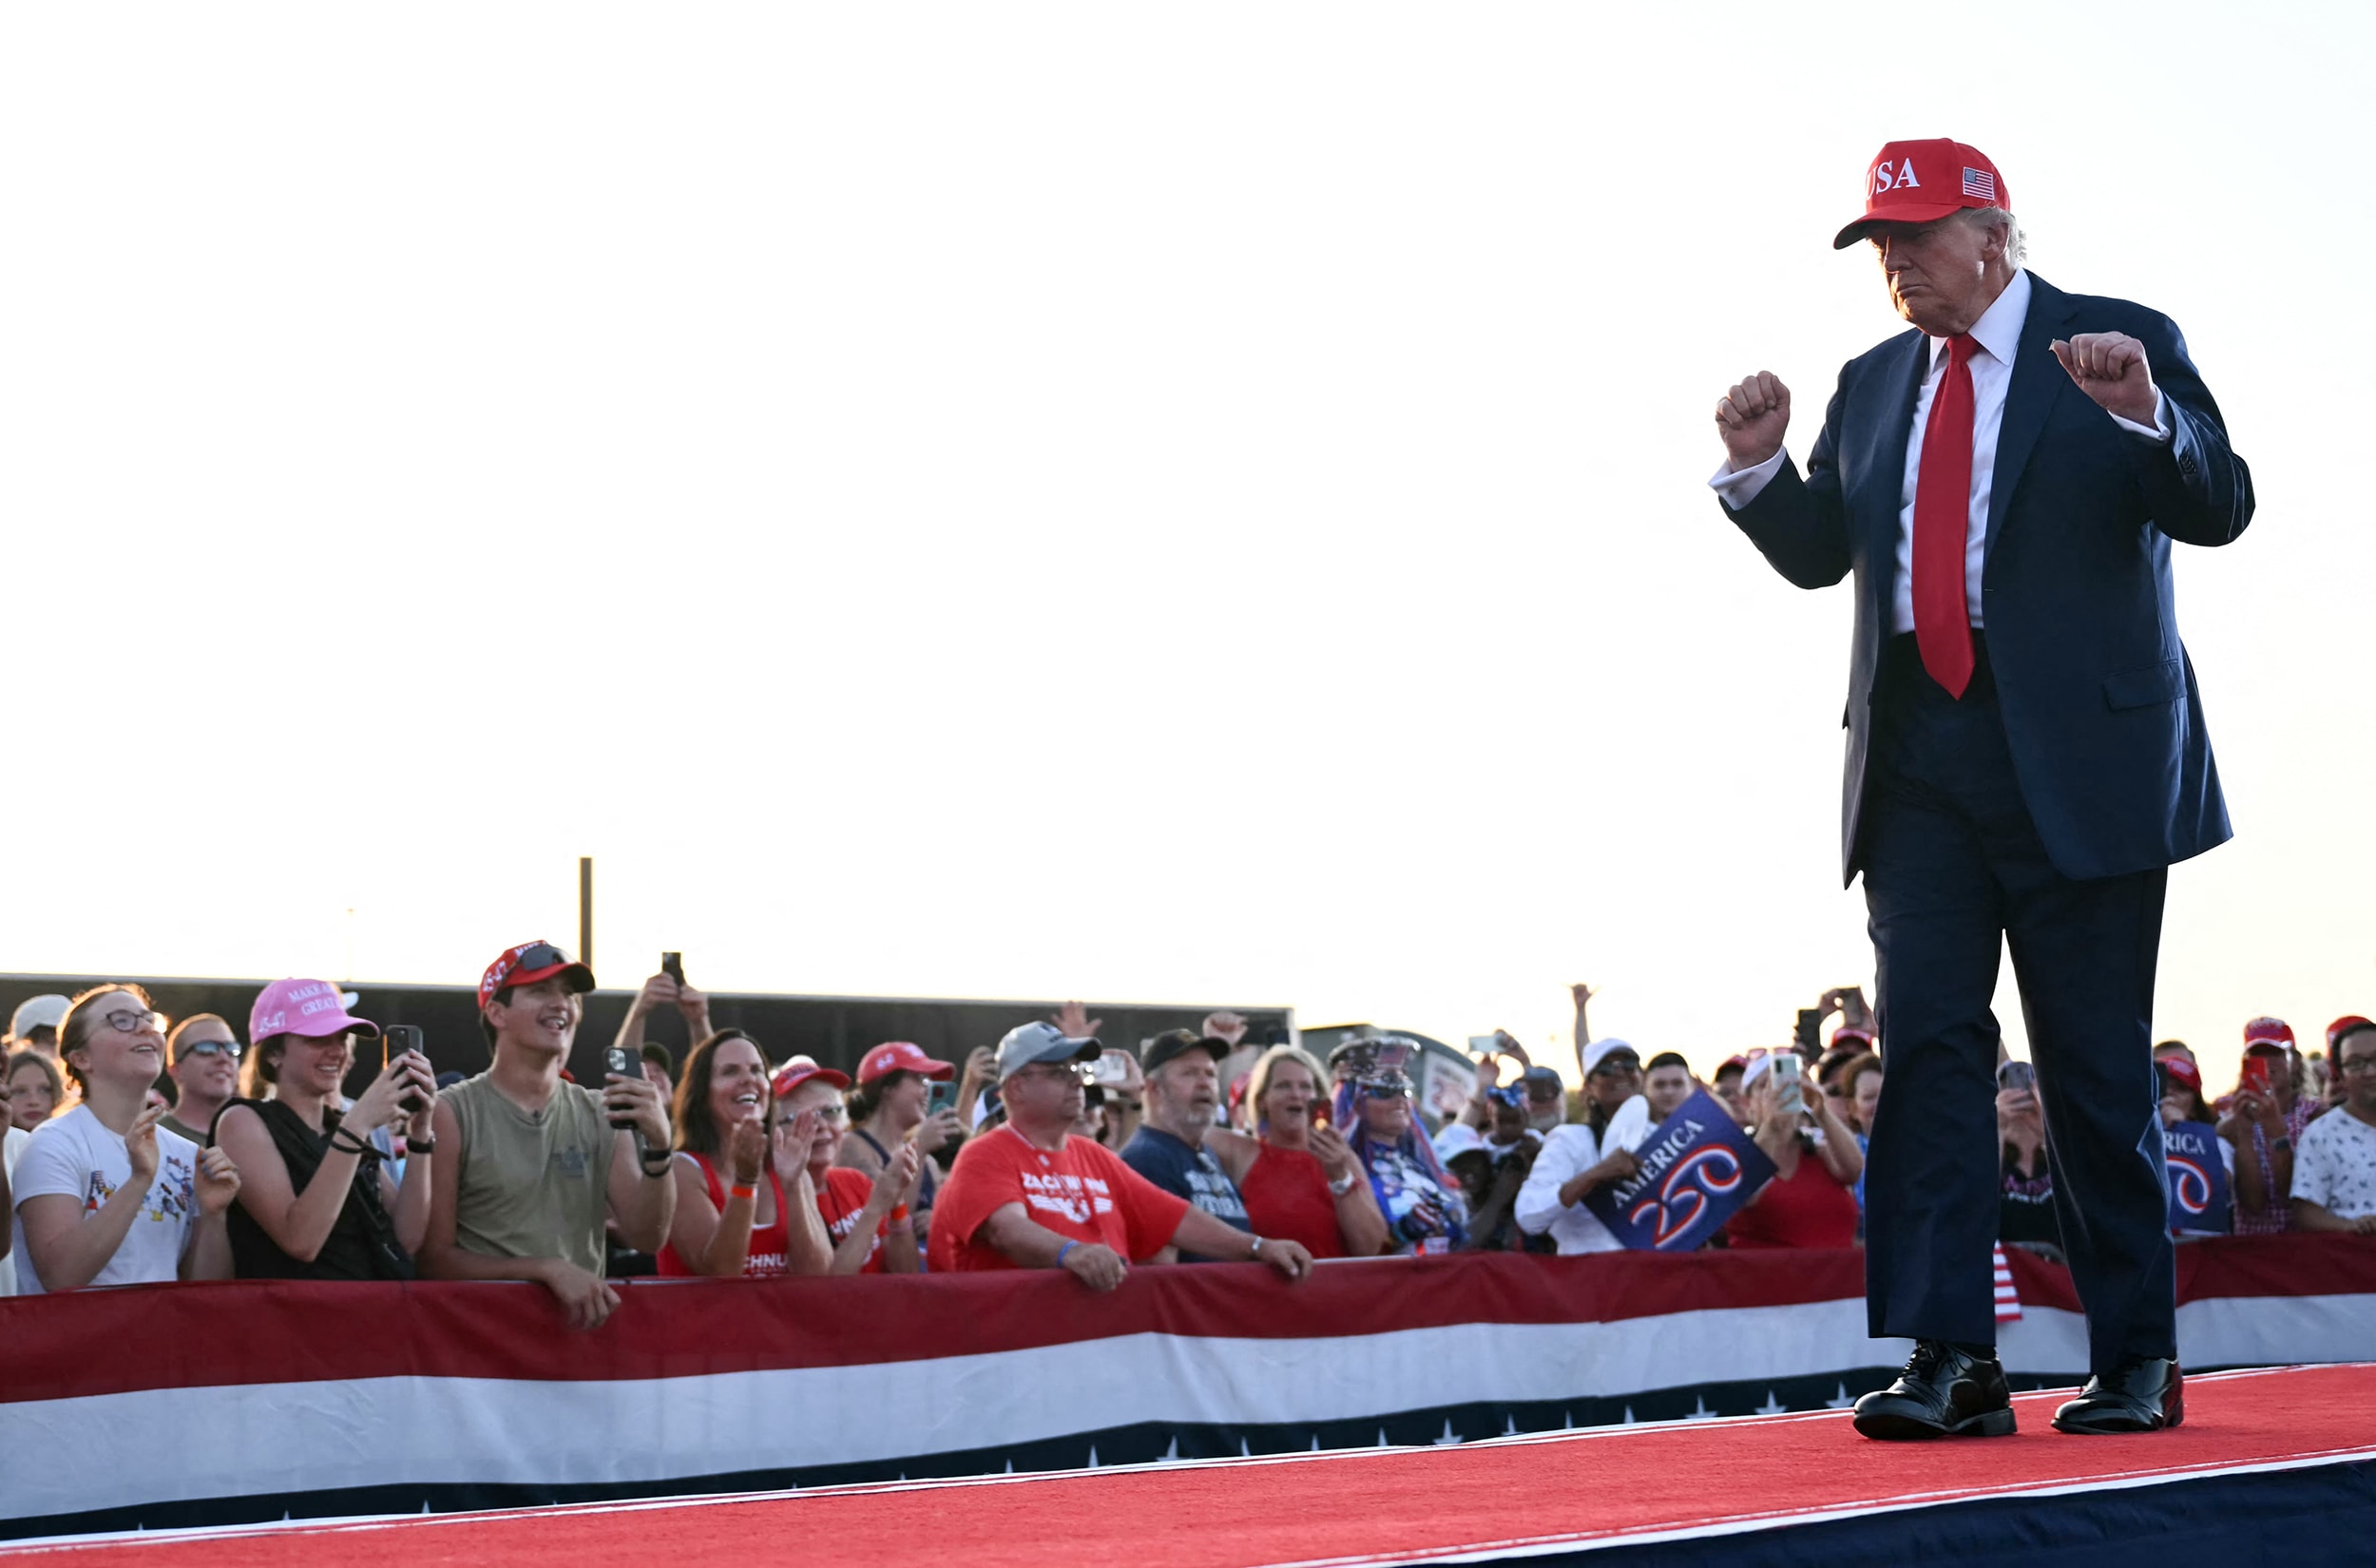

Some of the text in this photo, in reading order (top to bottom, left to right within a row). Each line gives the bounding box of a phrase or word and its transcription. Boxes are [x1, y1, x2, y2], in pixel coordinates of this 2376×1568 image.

[1866, 158, 1920, 200] USA
[288, 984, 322, 1003] MAKE
[301, 997, 336, 1016] GREAT
[1612, 1119, 1705, 1210] AMERICA
[1629, 1143, 1742, 1249] 250
